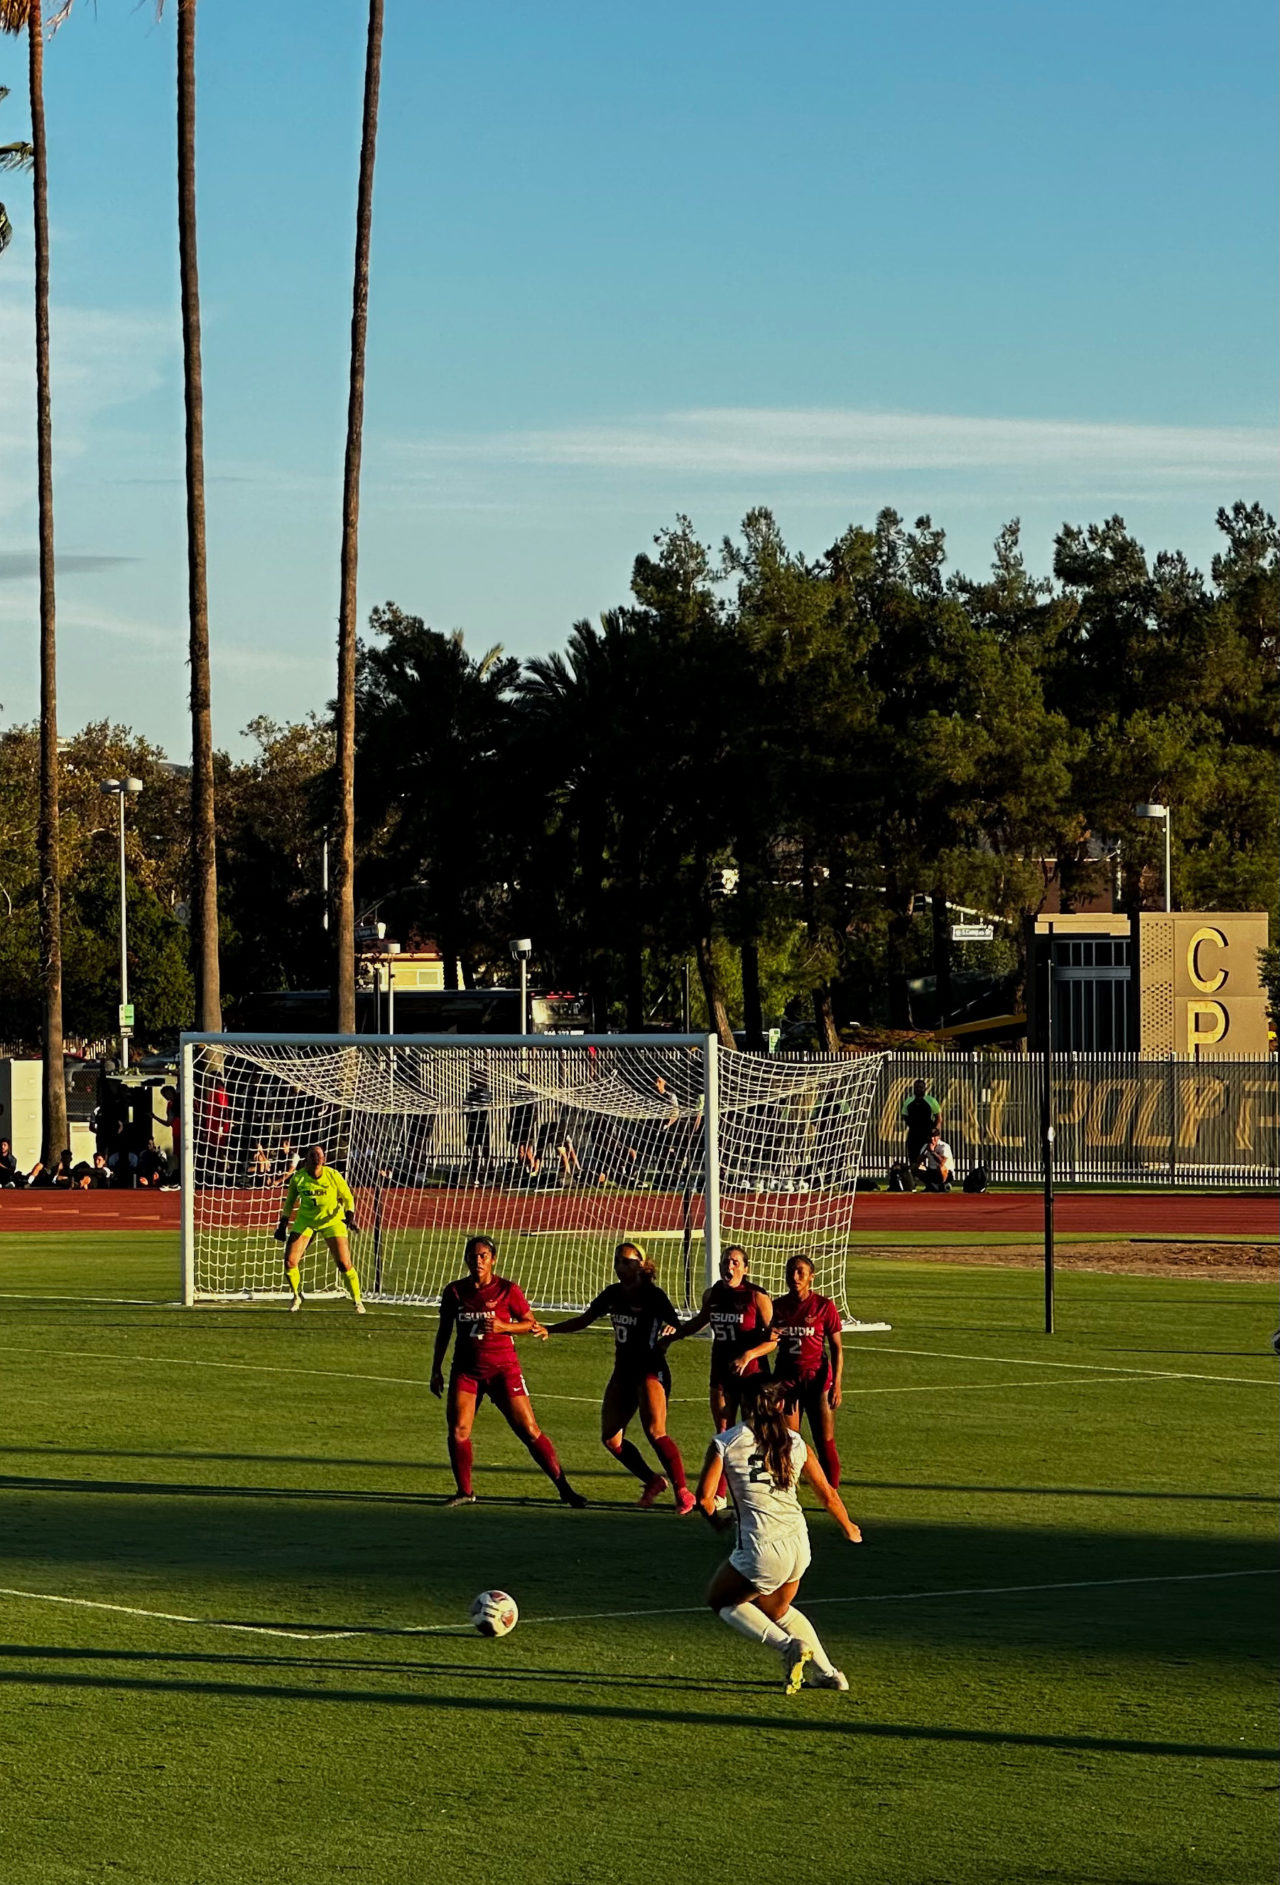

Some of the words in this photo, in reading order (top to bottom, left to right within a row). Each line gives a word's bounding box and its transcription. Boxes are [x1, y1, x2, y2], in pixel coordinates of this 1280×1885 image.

[709, 1311, 745, 1324] CSUDH
[713, 1323, 737, 1342] 51
[788, 1337, 803, 1355] 2
